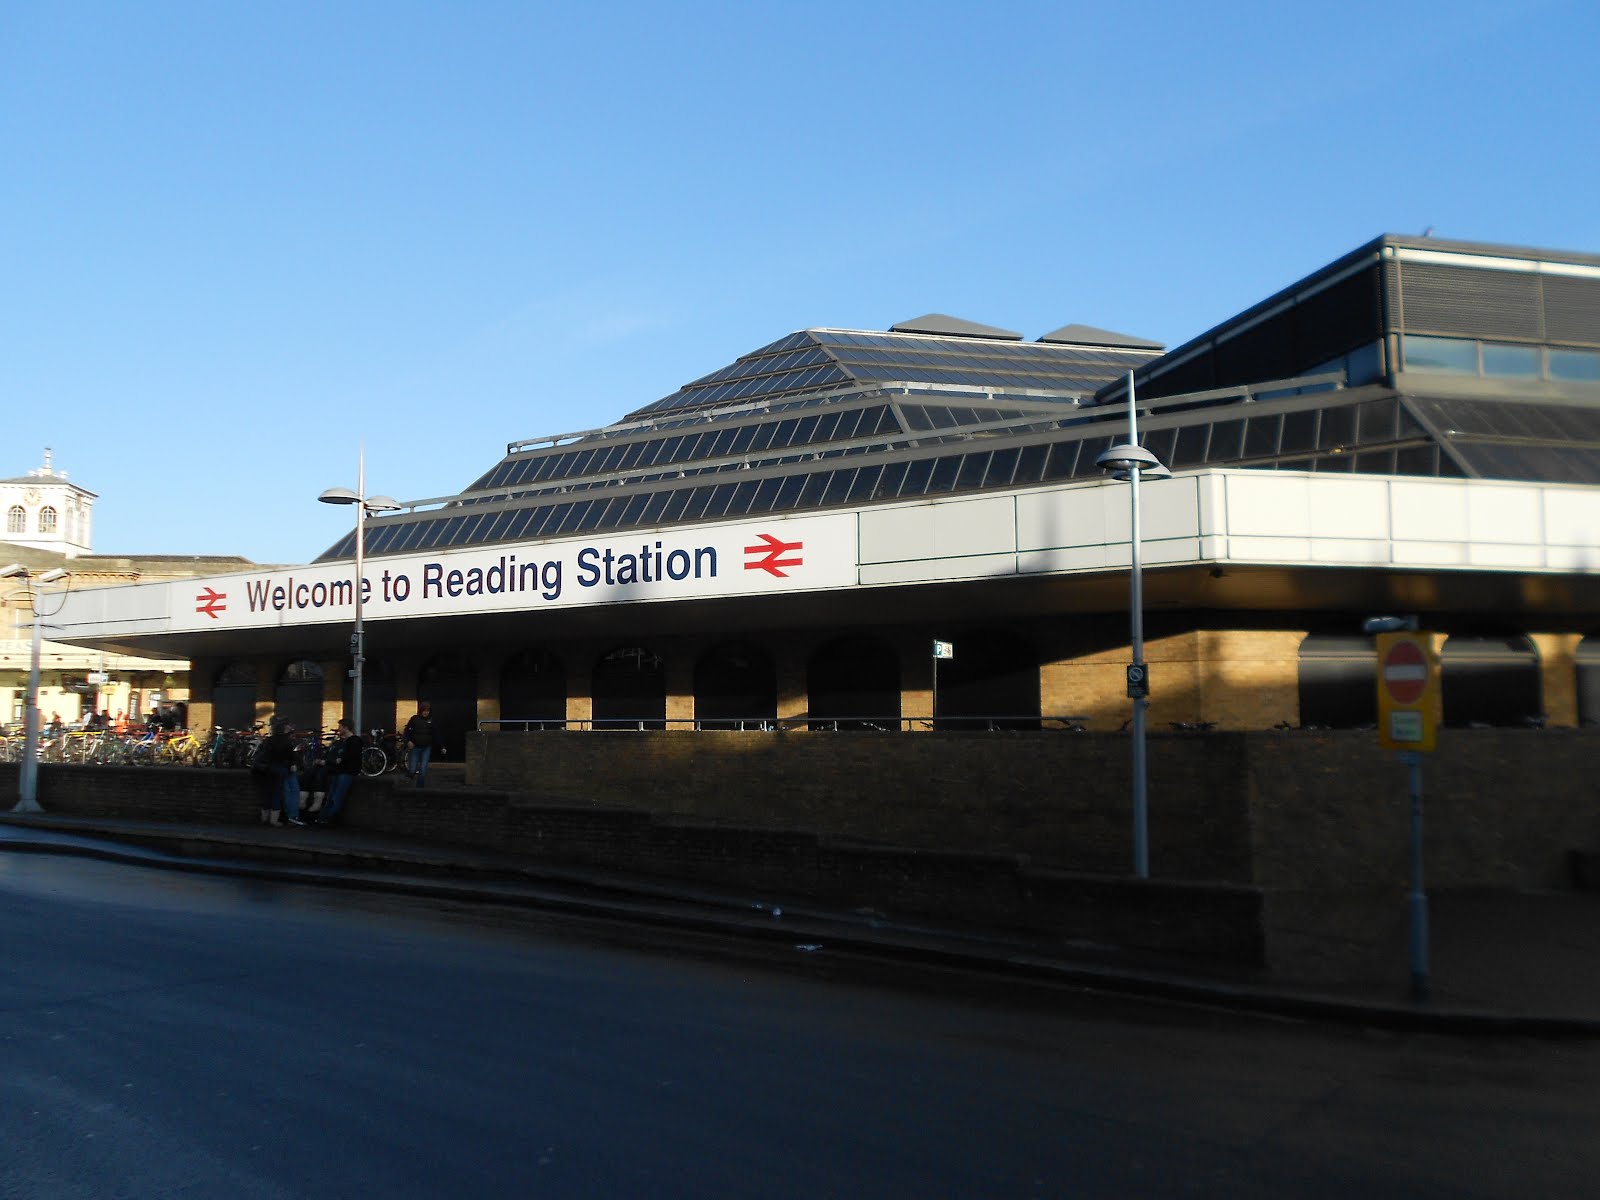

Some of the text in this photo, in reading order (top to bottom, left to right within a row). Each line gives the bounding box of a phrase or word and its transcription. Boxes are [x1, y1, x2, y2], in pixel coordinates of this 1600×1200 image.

[247, 541, 717, 613] Welcome to Reading Station
